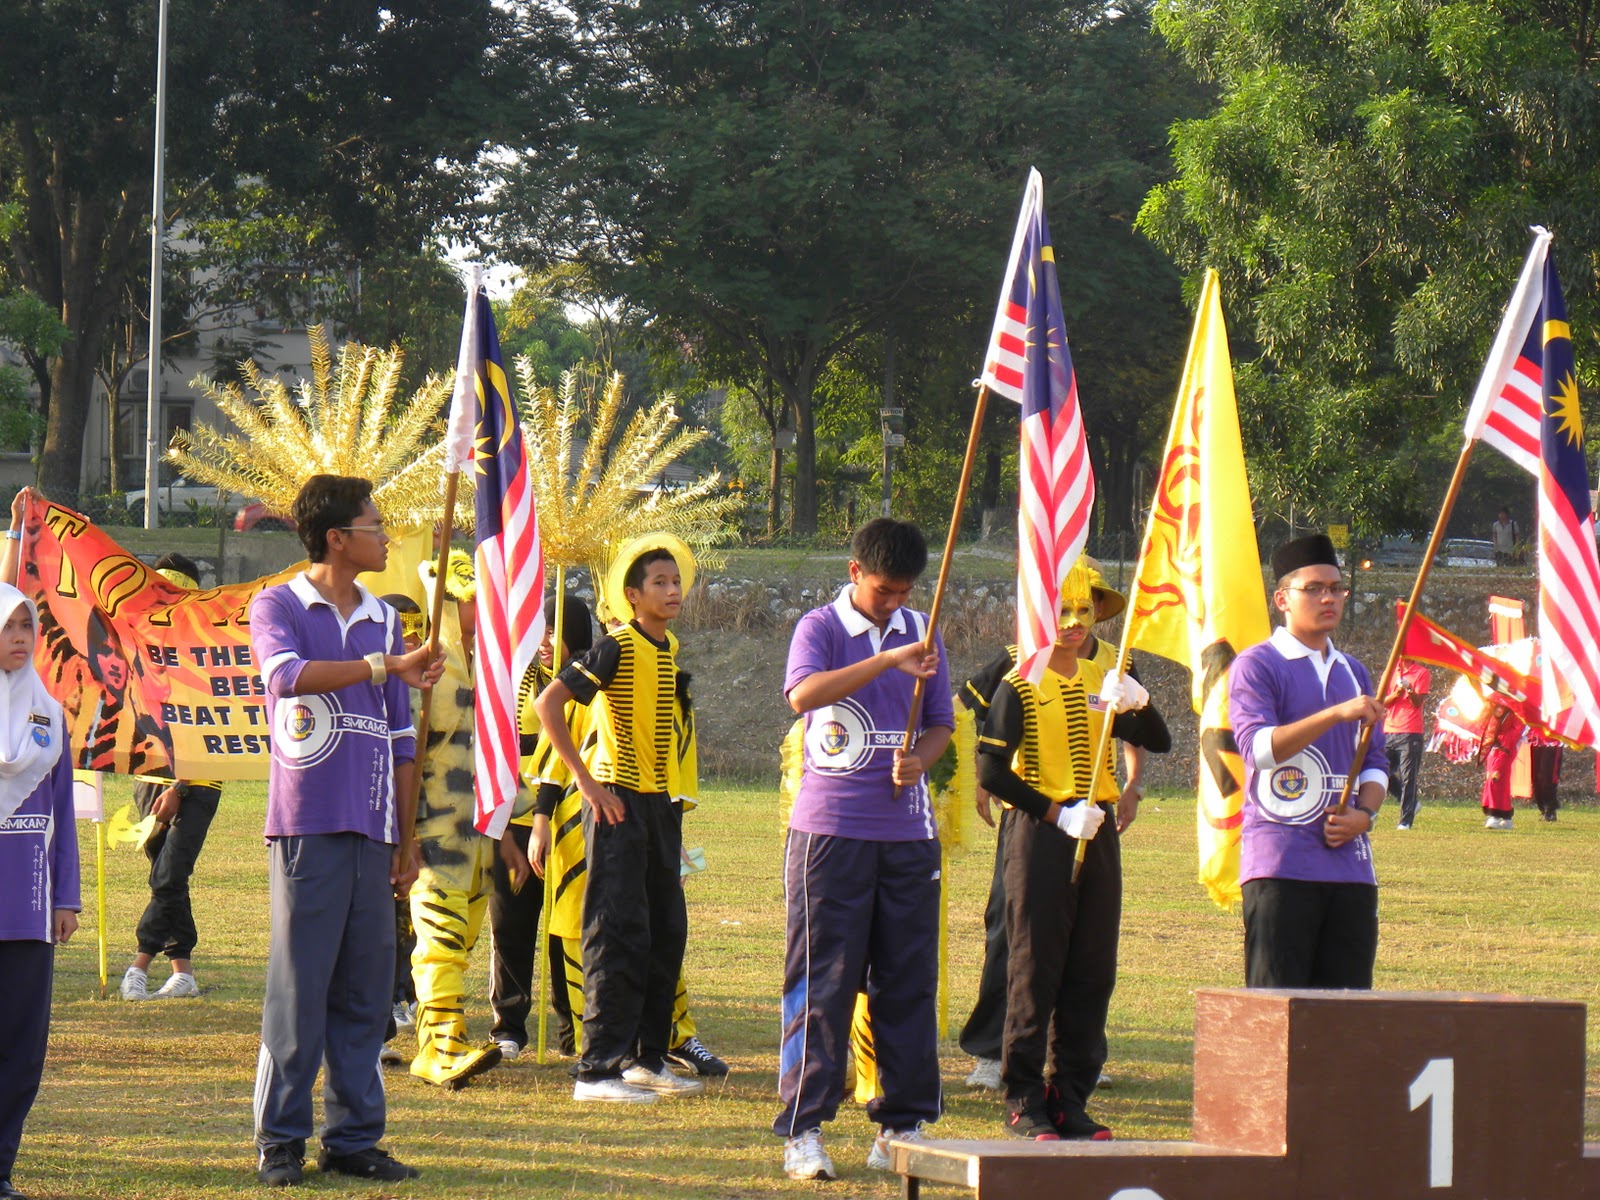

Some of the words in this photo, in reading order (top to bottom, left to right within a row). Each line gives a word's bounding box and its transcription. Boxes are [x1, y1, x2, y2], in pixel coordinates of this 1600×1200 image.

[146, 644, 180, 668] BE
[190, 645, 252, 667] THE
[210, 675, 265, 697] BES
[160, 702, 231, 726] BEAT
[203, 734, 271, 755] REST
[875, 734, 906, 745] SMKA
[1409, 1058, 1454, 1188] 1
